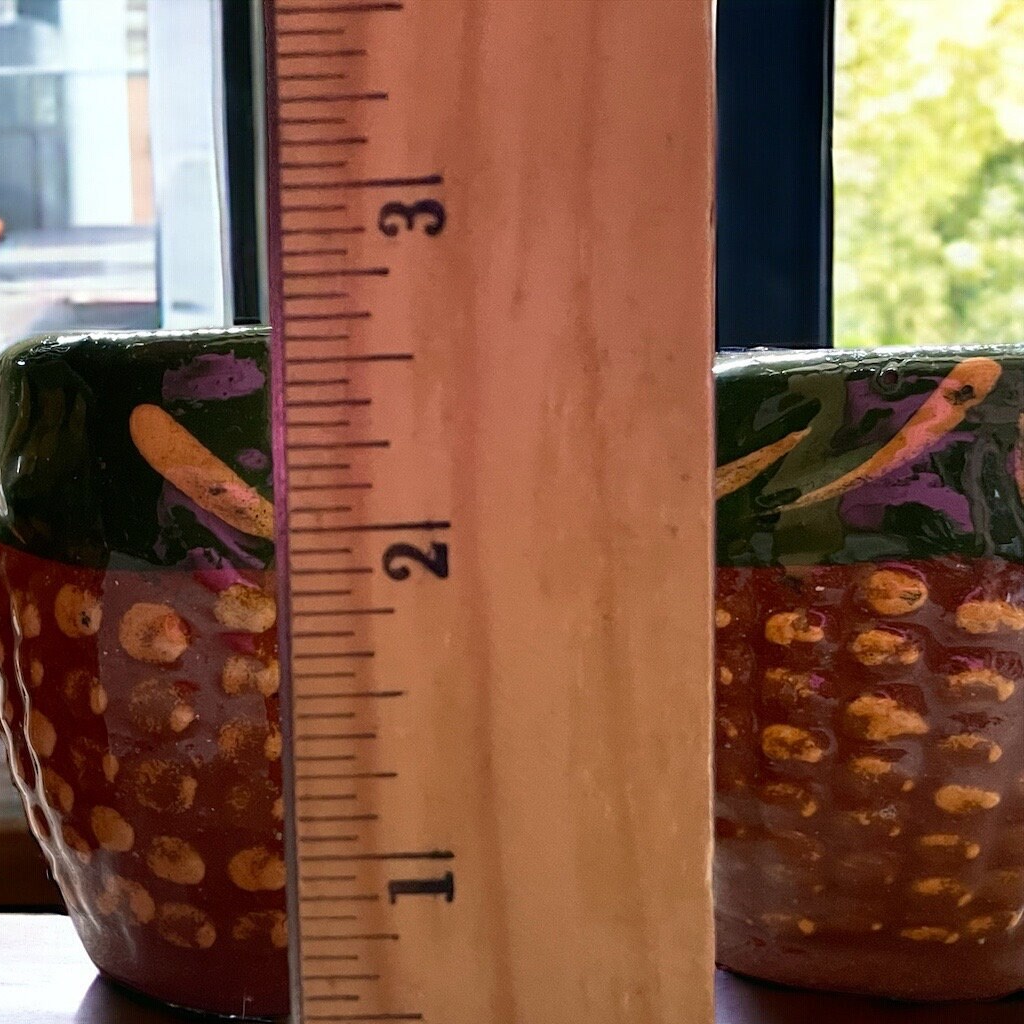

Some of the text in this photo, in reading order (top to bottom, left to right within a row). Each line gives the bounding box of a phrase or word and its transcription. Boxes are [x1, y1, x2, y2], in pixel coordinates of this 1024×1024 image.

[378, 198, 448, 238] 3
[382, 540, 450, 581] 2
[387, 870, 455, 904] 1
